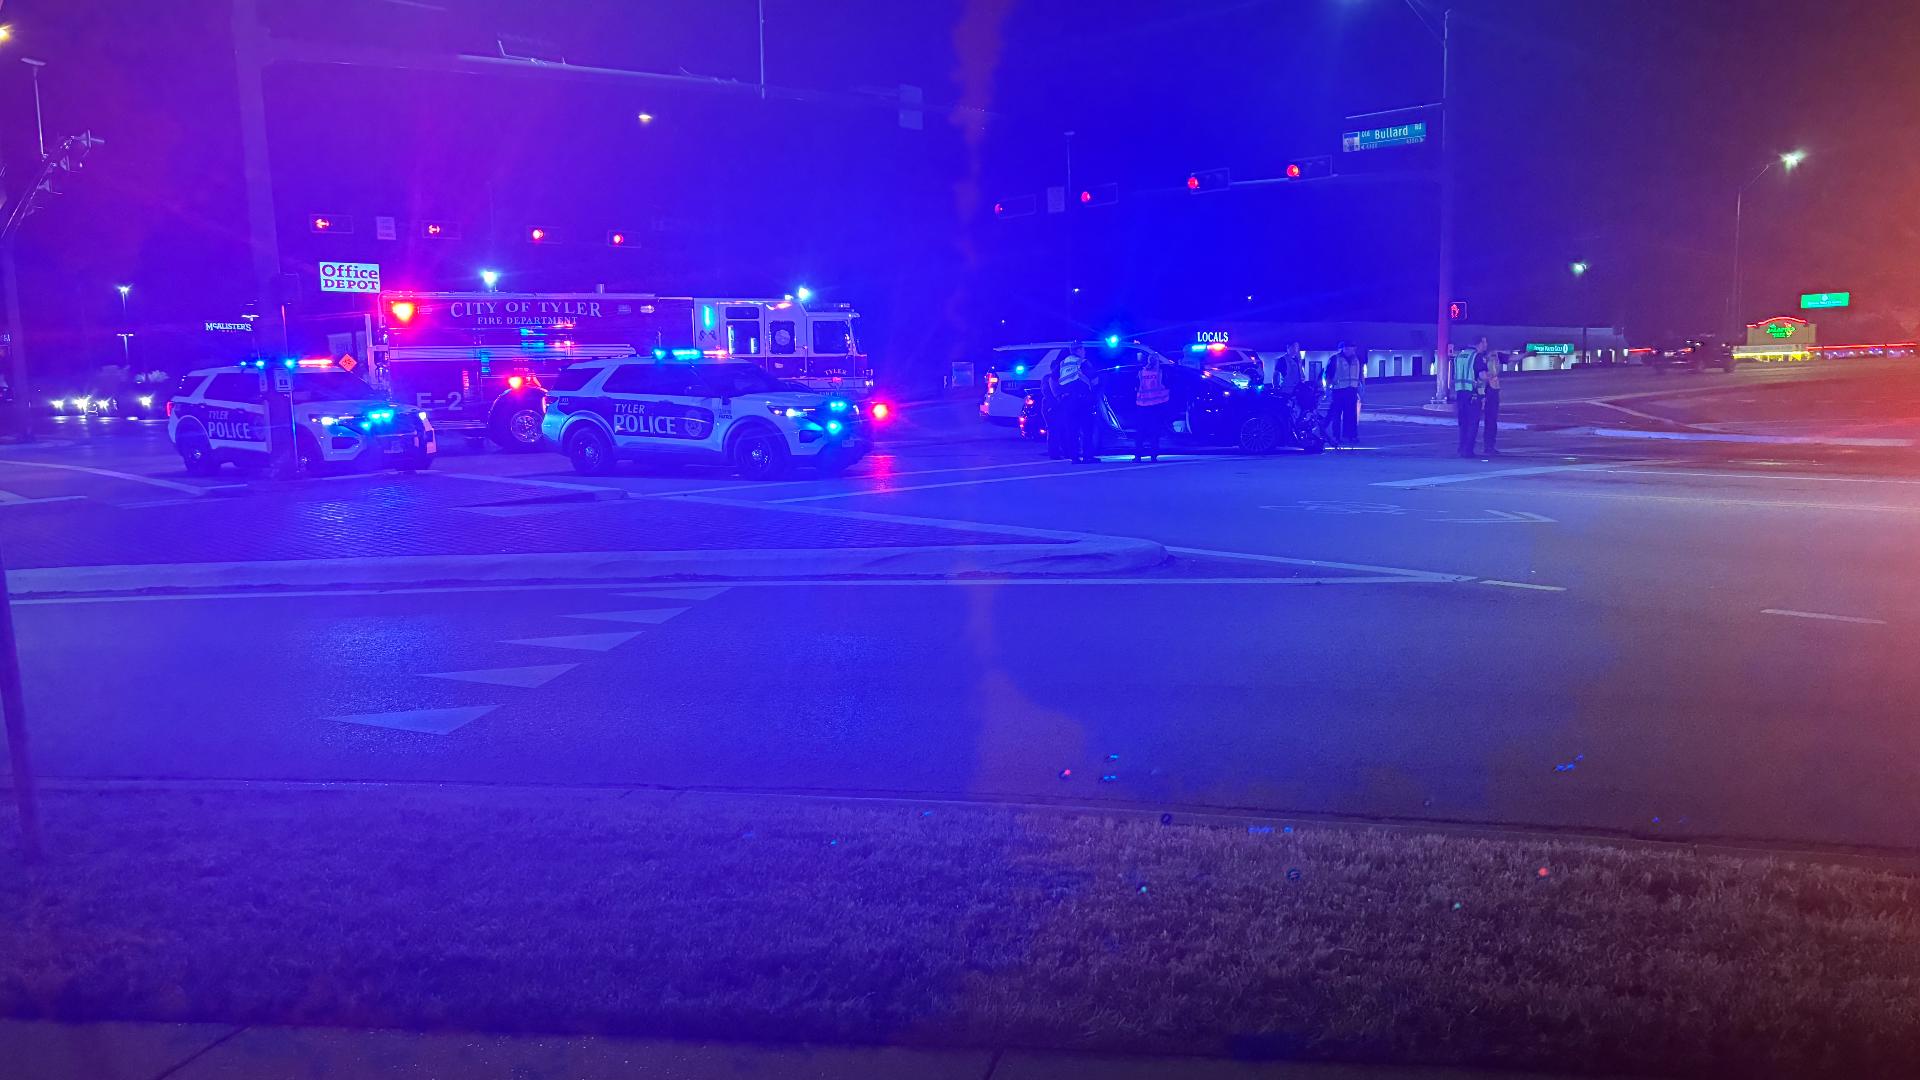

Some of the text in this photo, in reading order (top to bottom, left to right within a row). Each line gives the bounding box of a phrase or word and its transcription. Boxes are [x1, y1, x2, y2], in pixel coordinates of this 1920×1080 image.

[1374, 125, 1408, 140] Bullard
[321, 264, 378, 279] Office
[323, 279, 379, 290] DEPOT
[450, 301, 602, 318] CITY OF TYLER
[477, 316, 578, 325] FIRE DEPARTMENT
[1197, 331, 1229, 343] LOCALS
[824, 368, 847, 376] TYLER
[416, 391, 463, 411] E-2
[208, 410, 229, 420] TYLER
[615, 403, 646, 414] TYLER
[208, 421, 251, 439] POLICE
[613, 414, 677, 435] POLICE
